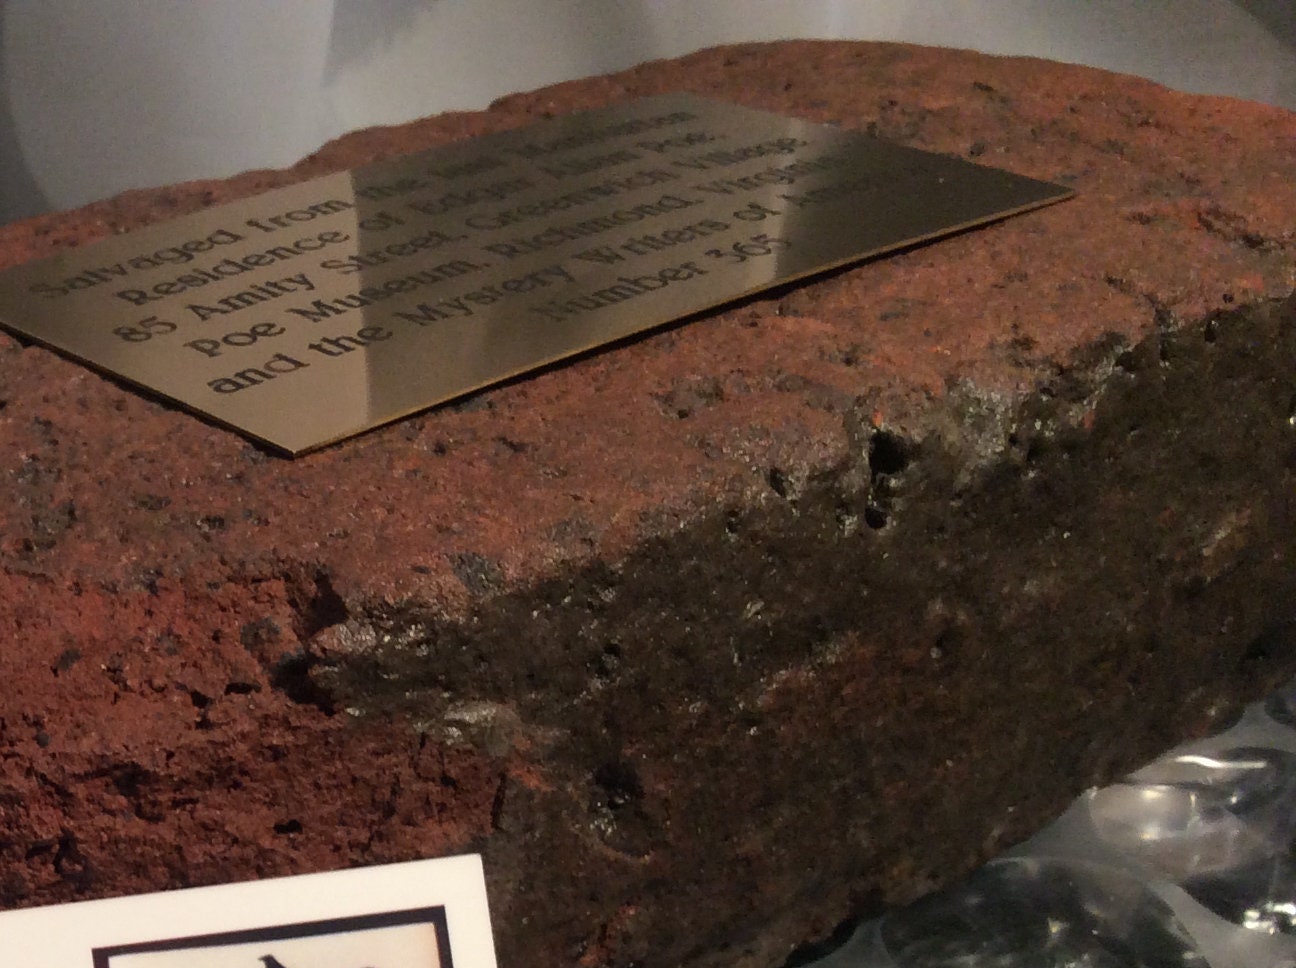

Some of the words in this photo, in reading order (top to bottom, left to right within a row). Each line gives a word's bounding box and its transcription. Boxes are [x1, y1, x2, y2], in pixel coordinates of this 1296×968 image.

[29, 228, 247, 298] Salvaged
[246, 199, 353, 233] from
[112, 316, 178, 343] 85
[186, 272, 316, 322] Amity
[465, 170, 681, 230] Greenwich
[116, 229, 352, 306] Residence
[359, 211, 405, 232] of
[527, 261, 709, 323] Number
[704, 233, 793, 263] 365
[183, 321, 286, 358] Poe
[207, 352, 310, 394] and
[308, 325, 393, 358] the
[392, 266, 575, 326] Mystery
[571, 219, 731, 264] Writers
[732, 202, 782, 222] of
